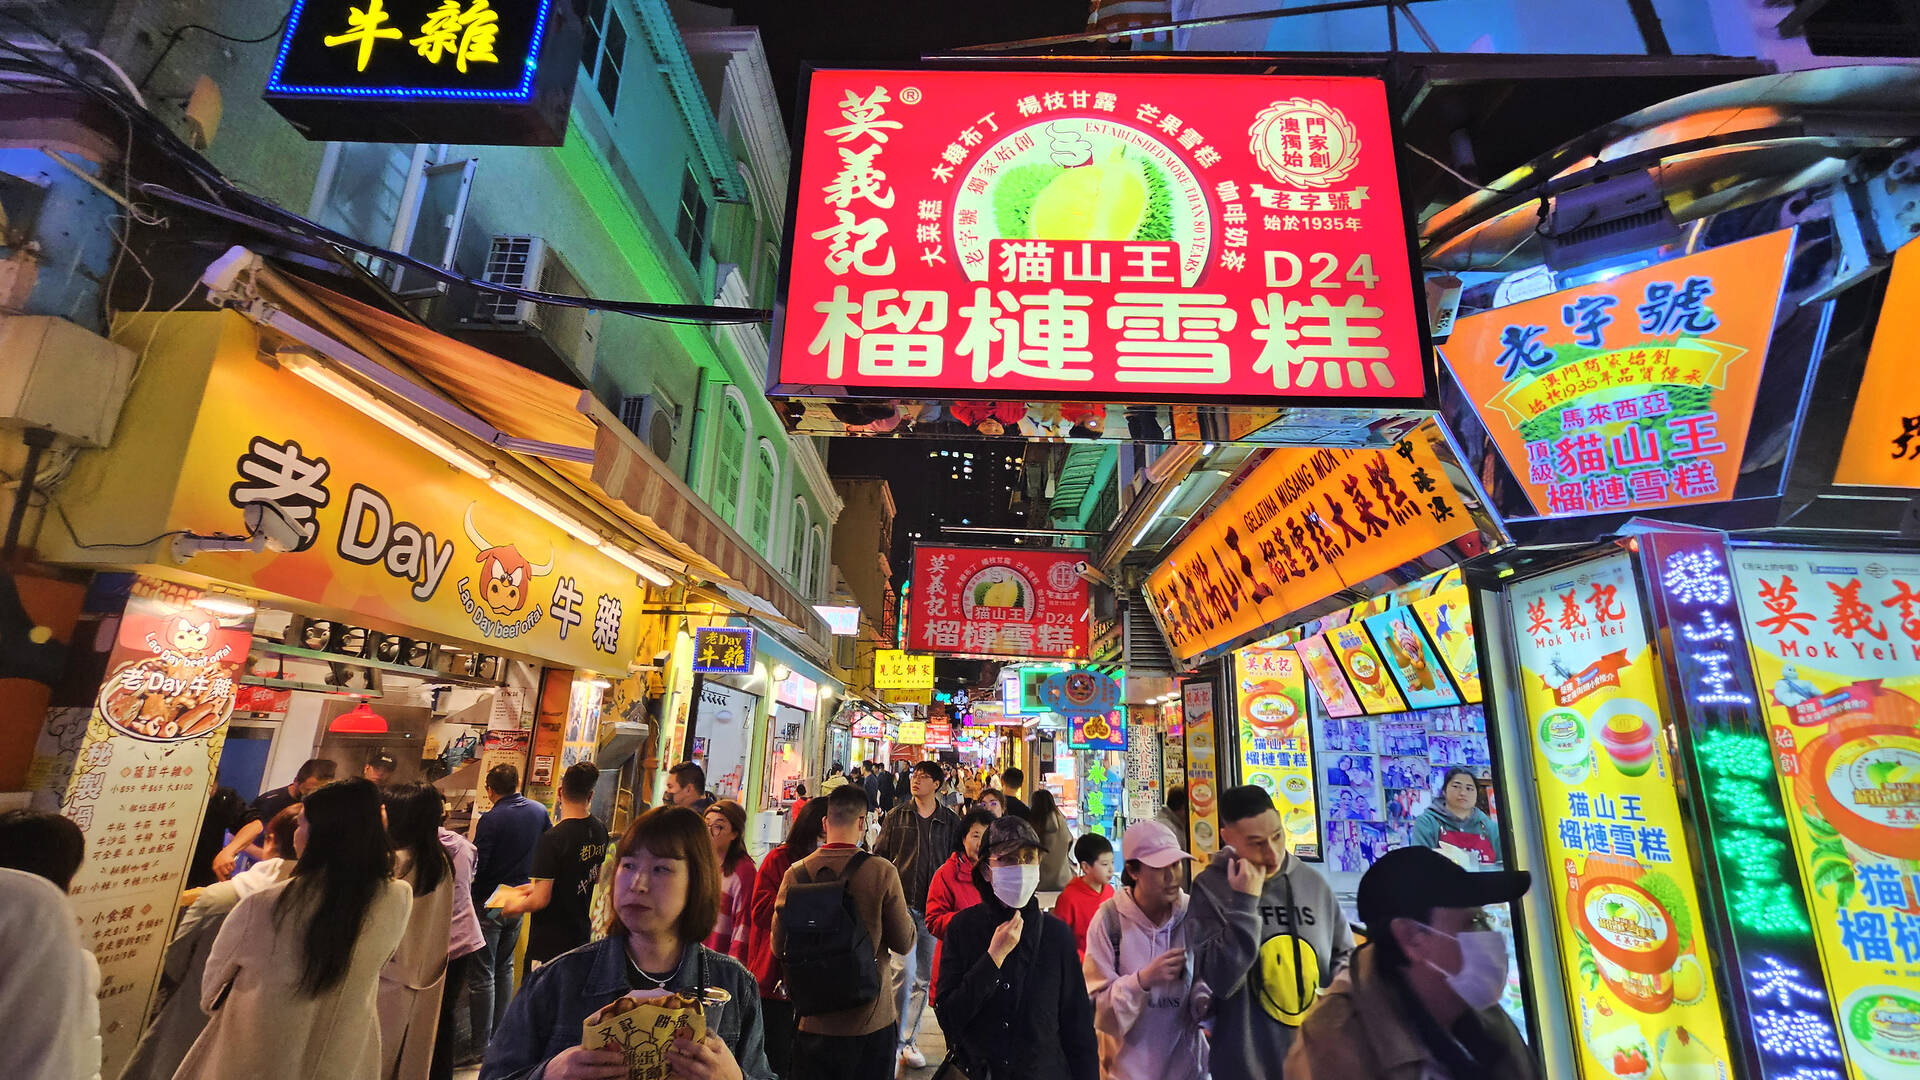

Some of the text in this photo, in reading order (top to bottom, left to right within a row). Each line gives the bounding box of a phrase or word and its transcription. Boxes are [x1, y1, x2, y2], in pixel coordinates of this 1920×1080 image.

[325, 0, 499, 73] 牛雜
[1017, 90, 1117, 117] 楊枝甘露
[1085, 122, 1167, 160] ESTABLISHED
[1136, 103, 1222, 168] 芒果雪糕
[811, 86, 903, 276] 莫義記
[1163, 156, 1192, 188] MORE
[1185, 184, 1205, 218] THAN
[1271, 191, 1353, 211] 老字號
[916, 199, 947, 267] 大菜糕
[1215, 180, 1248, 272] 咖啡奶茶
[1263, 214, 1363, 232] 始於1935年
[1184, 236, 1206, 274] YEARS
[1264, 250, 1381, 290] D24
[808, 286, 1396, 390] 榴槤雪糕
[1495, 276, 1720, 382] 老字號
[1561, 392, 1670, 429] 馬來西亞
[1554, 413, 1727, 478] 貓山王
[1243, 494, 1281, 534] GELATINA
[1274, 463, 1316, 508] MUSANG
[1548, 460, 1718, 513] 榴槤雪糕
[457, 576, 544, 639] Lao Day beef offal
[550, 576, 622, 655] 牛雜
[1045, 612, 1075, 625] D24
[1526, 583, 1626, 637] 莫義記
[145, 631, 163, 654] Lao
[160, 649, 183, 668] Day
[209, 644, 233, 664] offal
[1535, 621, 1624, 649] Mok Yei Kei
[1778, 639, 1839, 659] Mok
[1851, 642, 1898, 661] Yei
[697, 645, 745, 669] 牛雜
[1856, 863, 1920, 908] 猫
